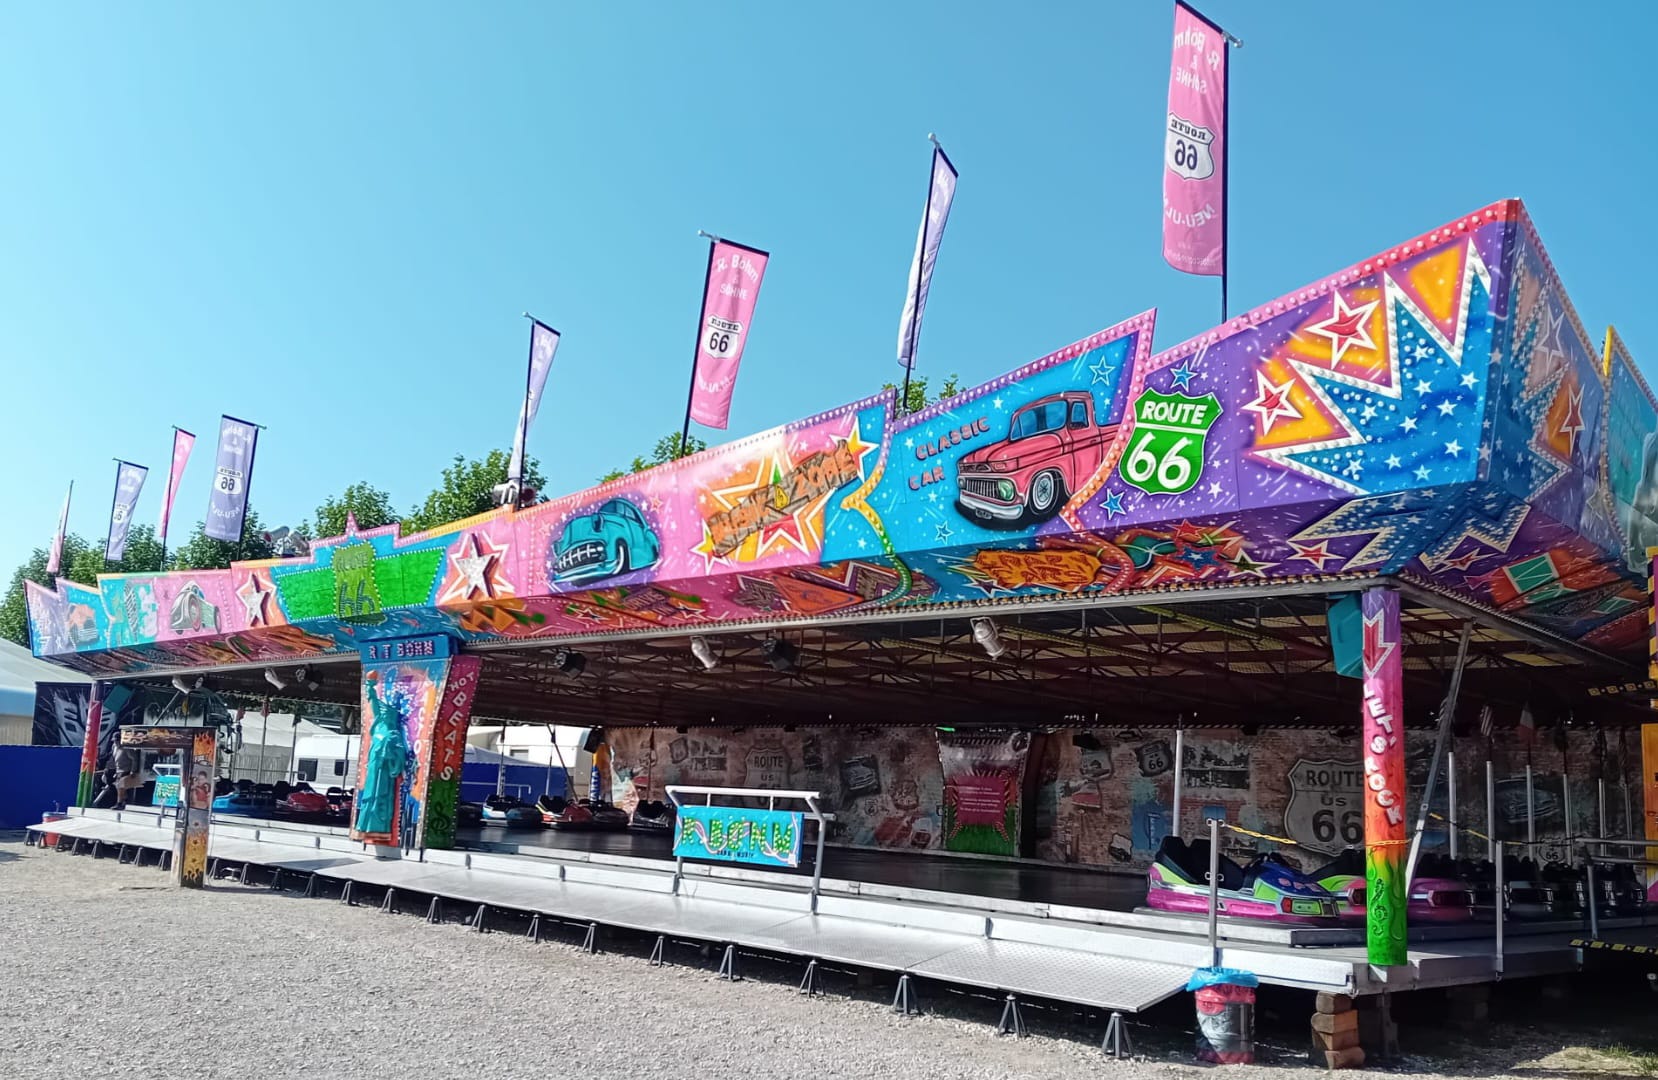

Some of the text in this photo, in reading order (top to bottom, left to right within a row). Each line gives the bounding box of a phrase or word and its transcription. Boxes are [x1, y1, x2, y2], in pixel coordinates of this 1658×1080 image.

[711, 317, 740, 331] ROUTE
[709, 332, 730, 353] 66
[1140, 400, 1209, 425] ROUTE
[915, 416, 990, 460] CLASSIC
[1126, 430, 1193, 489] 66
[908, 465, 946, 491] CAR
[440, 671, 475, 781] HOT BEATS
[753, 755, 784, 769] ROUTE
[1147, 759, 1164, 770] 66
[760, 773, 775, 782] US
[1306, 770, 1364, 787] ROUTE
[1364, 755, 1403, 826] ROCK
[1312, 809, 1363, 844] 66
